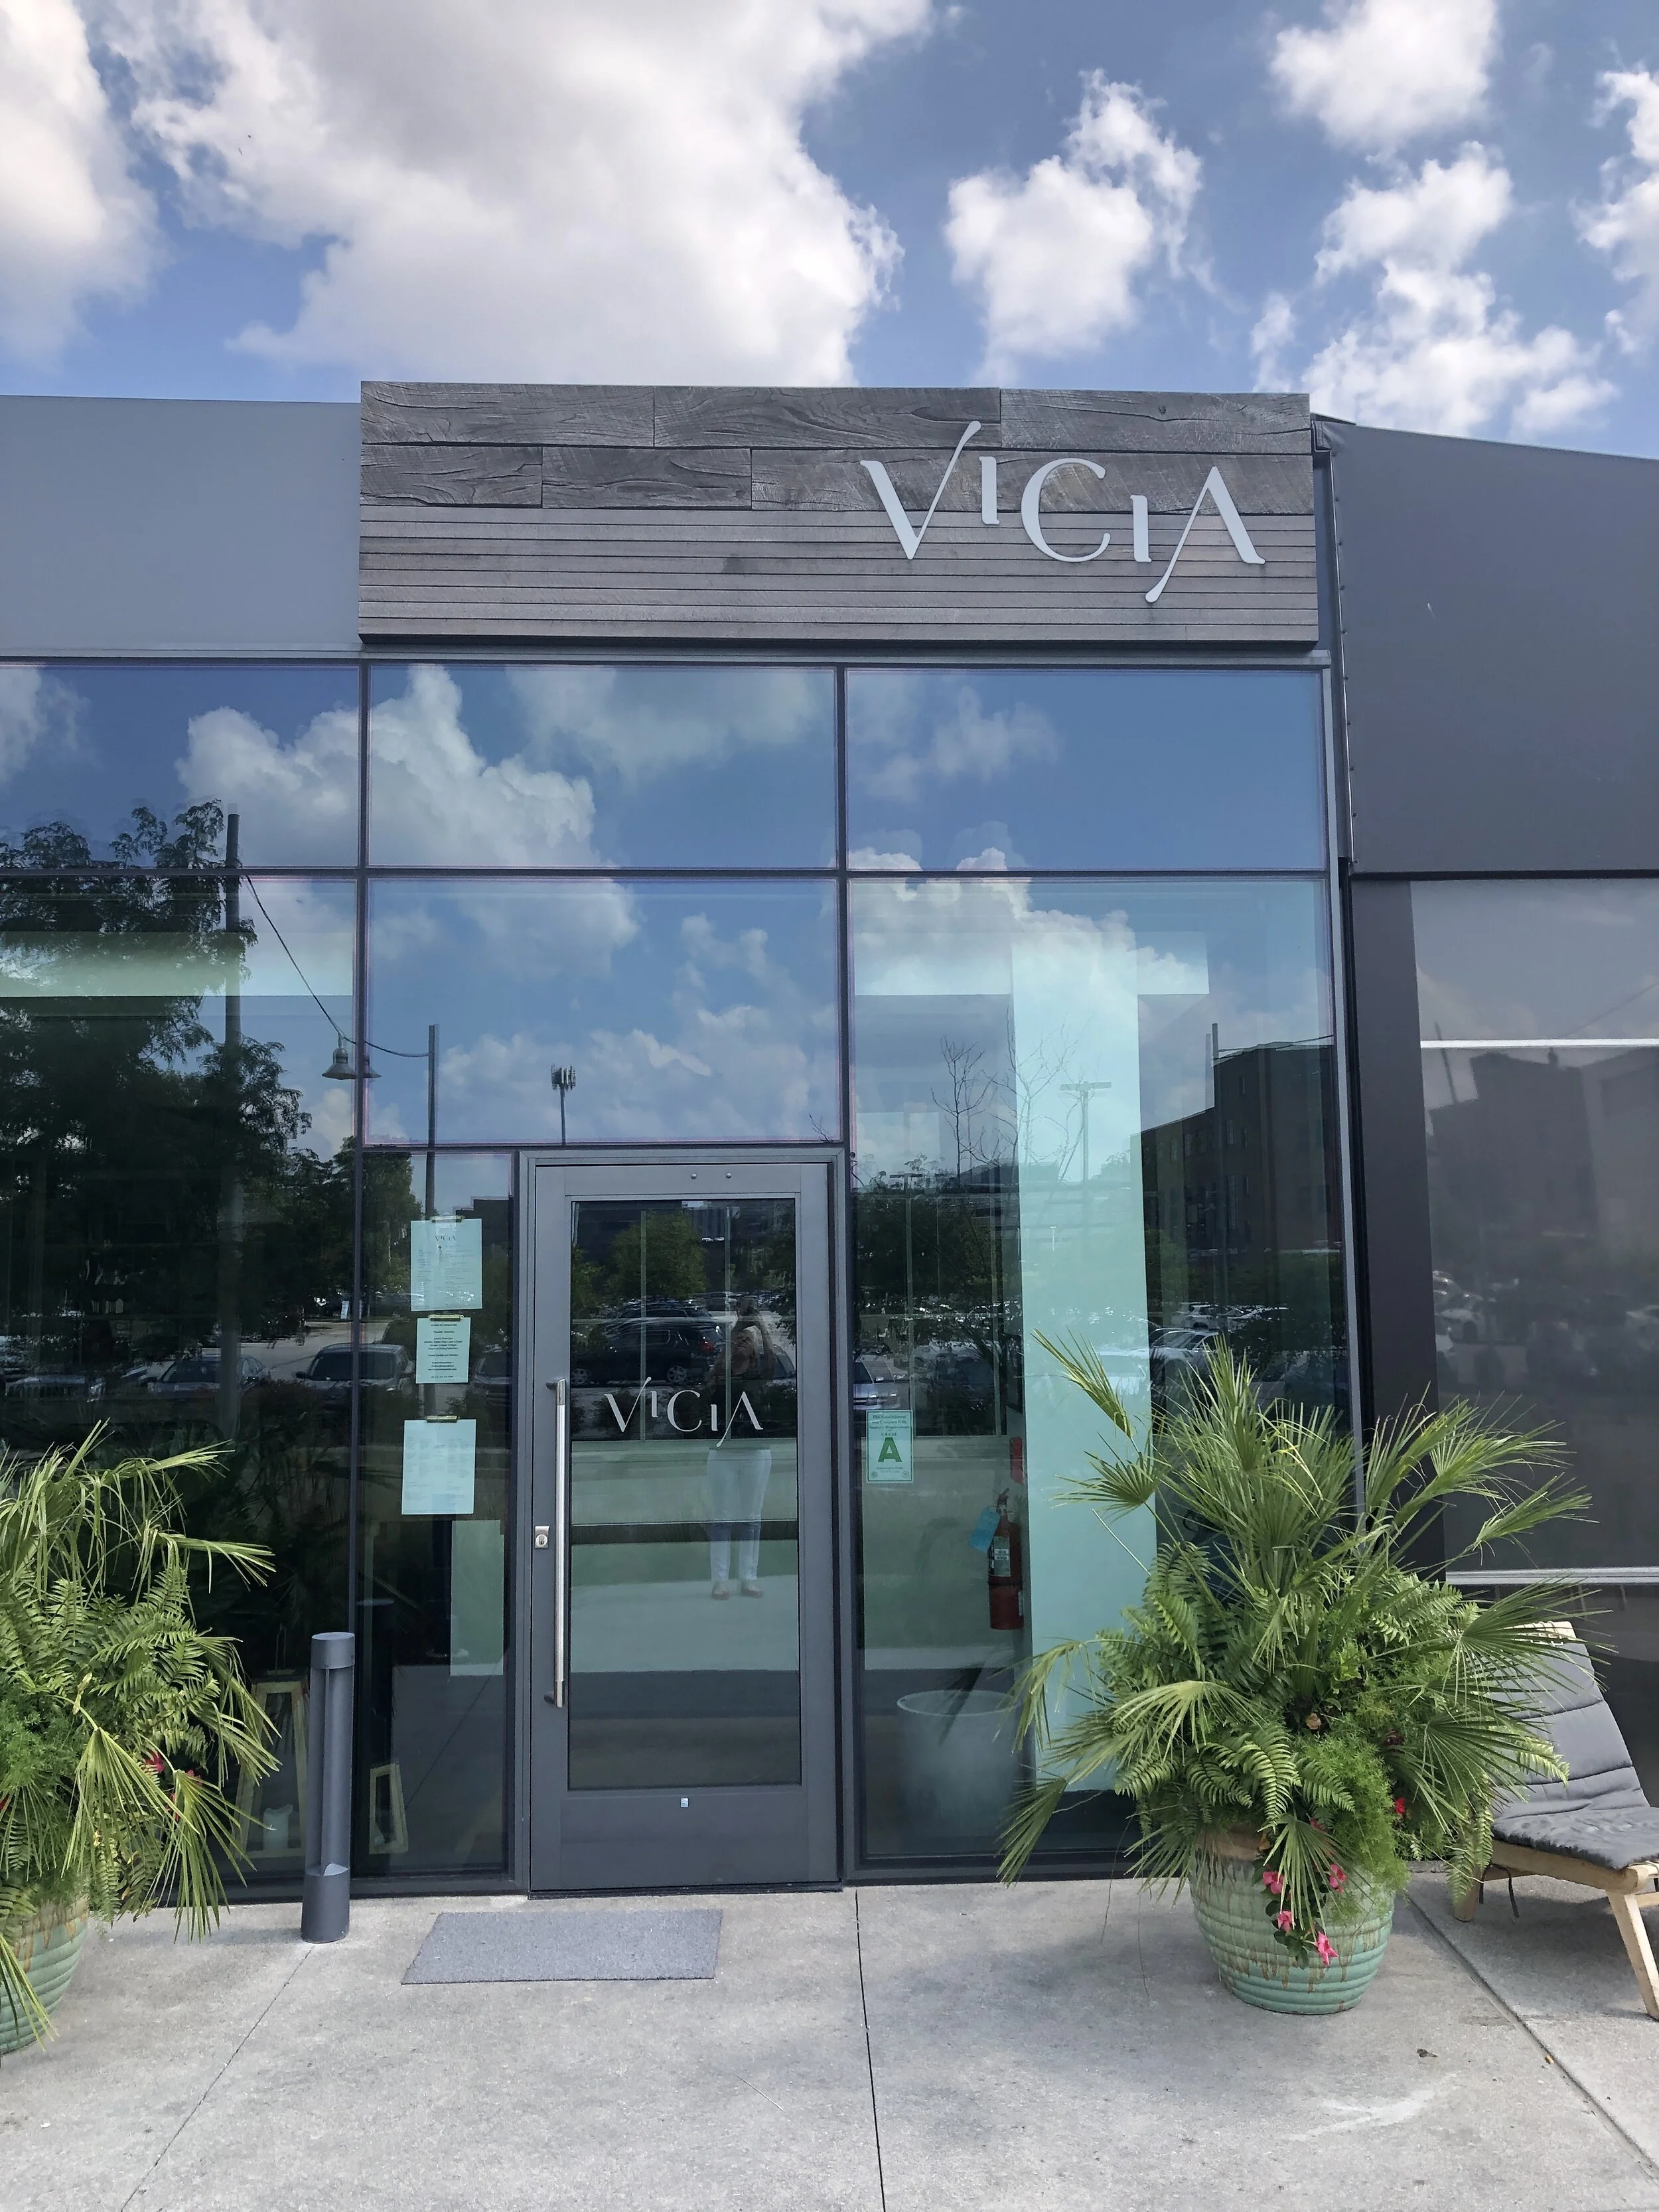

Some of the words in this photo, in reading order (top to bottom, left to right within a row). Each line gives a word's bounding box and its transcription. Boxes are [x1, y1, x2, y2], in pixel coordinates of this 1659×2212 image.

[860, 420, 1265, 603] VICIA
[604, 1376, 764, 1447] VICIA
[877, 1437, 902, 1463] A
